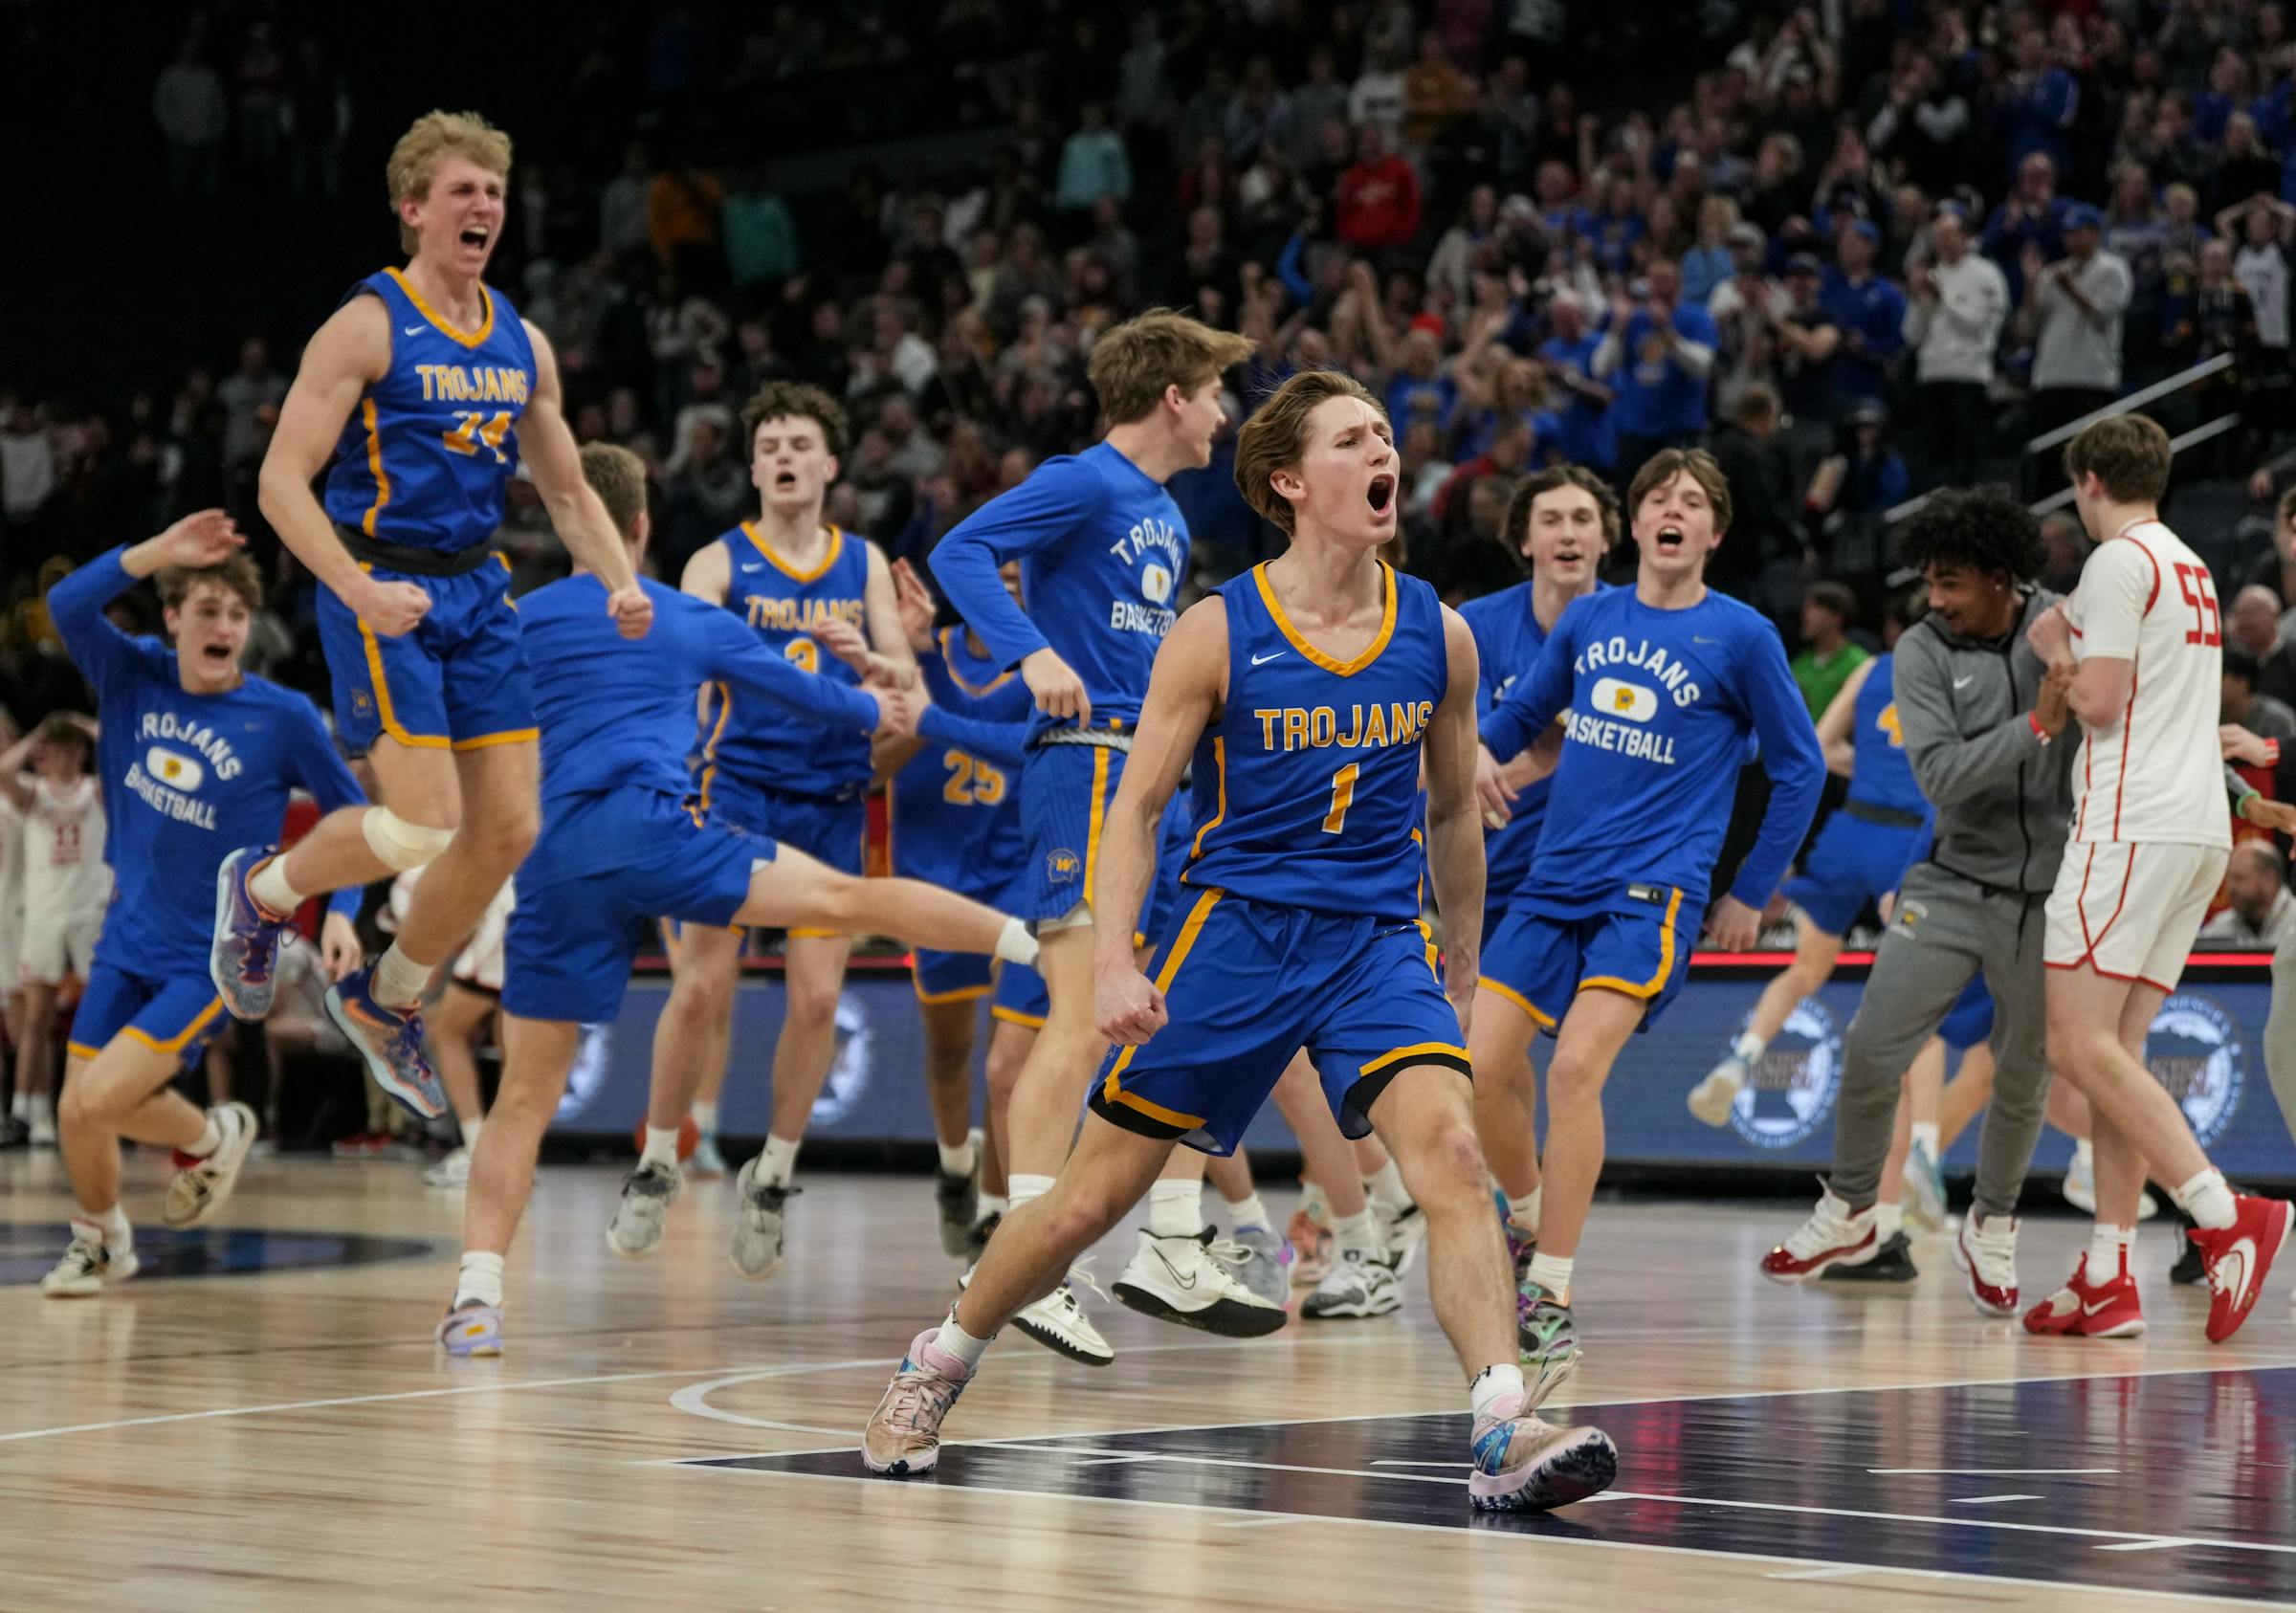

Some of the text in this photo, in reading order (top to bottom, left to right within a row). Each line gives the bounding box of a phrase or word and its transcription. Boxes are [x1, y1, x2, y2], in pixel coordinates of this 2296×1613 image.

[415, 365, 528, 406] TROJANS
[443, 410, 512, 464] 24
[744, 595, 863, 631] TROJANS
[2173, 562, 2221, 647] 55
[134, 712, 243, 781] ROJANS
[1254, 701, 1433, 751] TROJANS
[1565, 713, 1675, 764] ASKETBALL
[123, 762, 216, 831] BSKETBALL
[942, 749, 1005, 806] 25
[1321, 762, 1360, 834] 1
